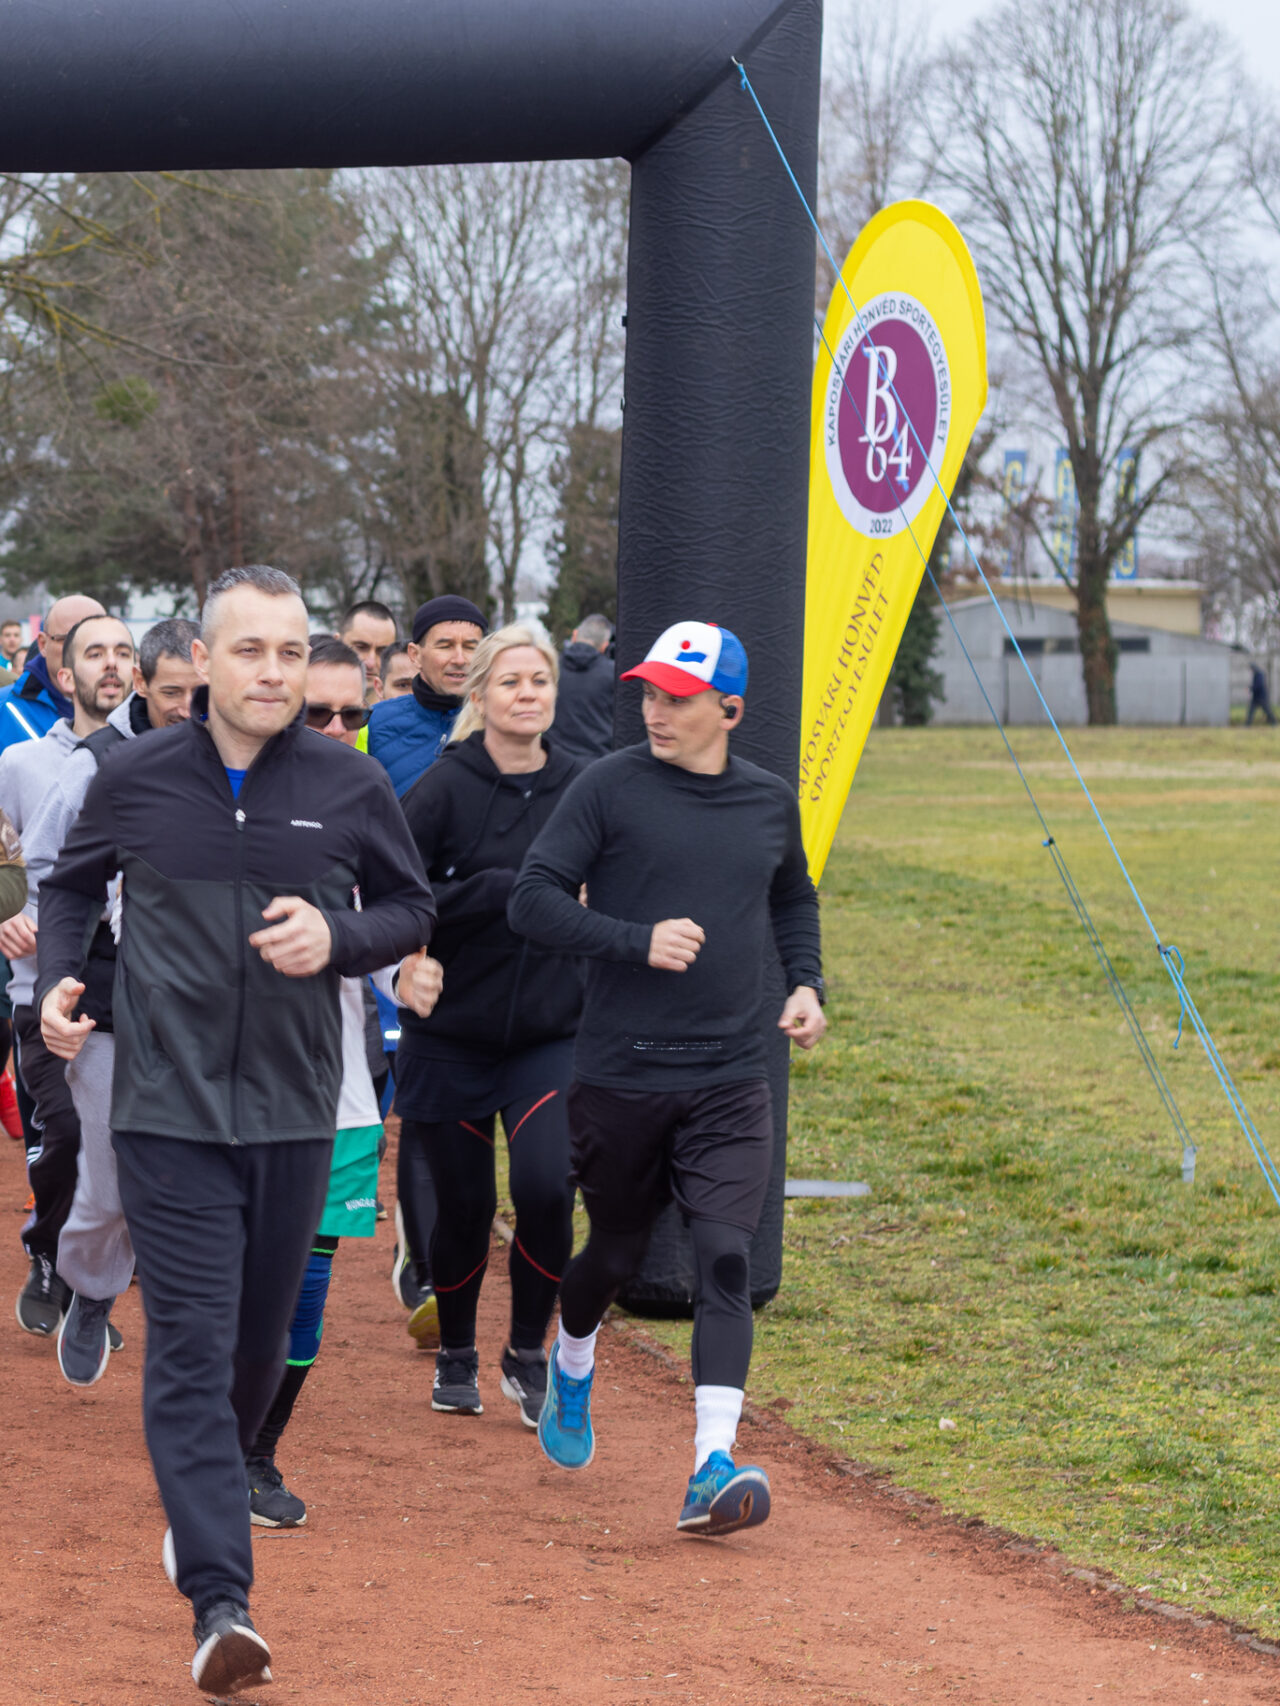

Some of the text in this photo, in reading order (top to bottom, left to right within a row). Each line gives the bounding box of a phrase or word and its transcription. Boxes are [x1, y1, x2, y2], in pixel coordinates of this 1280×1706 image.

[828, 296, 951, 447] KAPOSVÁRI HONVÉD SPORTEGYESÜLET
[869, 519, 893, 534] 2022
[837, 552, 884, 669] HONVÉD
[809, 586, 888, 802] SPORTEGYESÜLET
